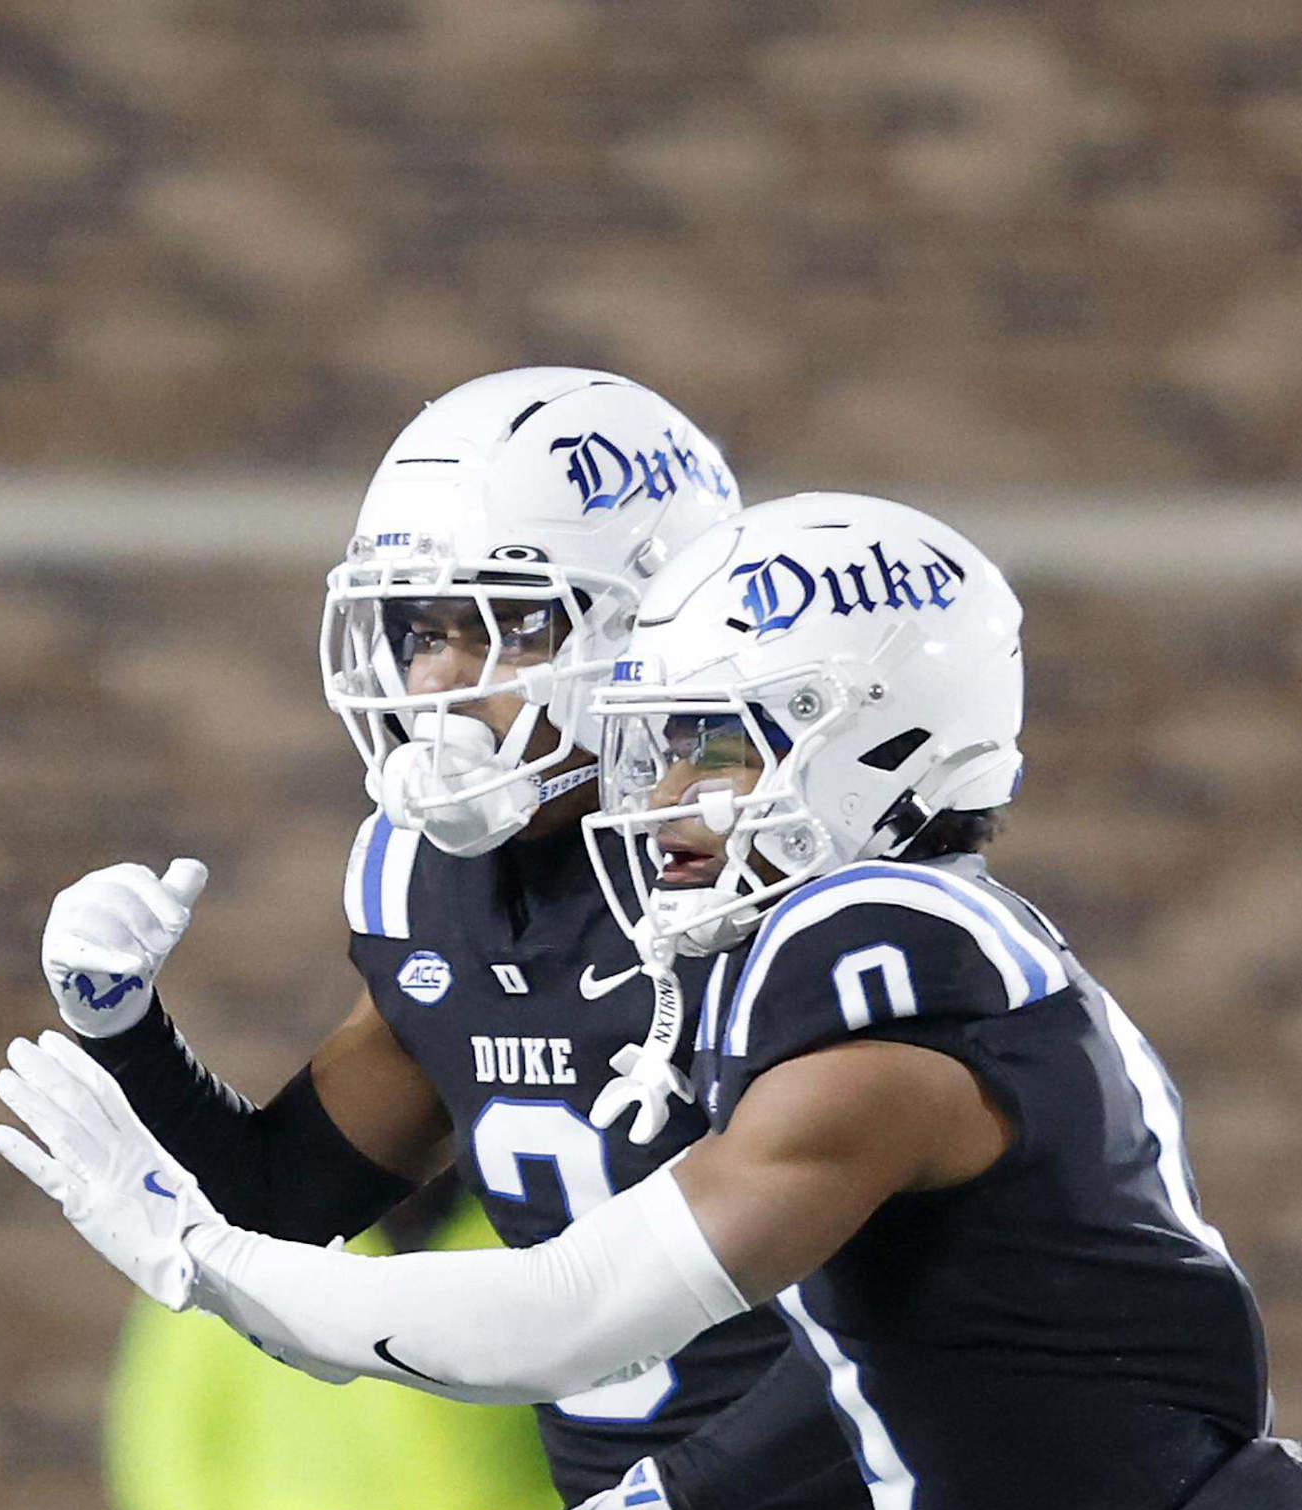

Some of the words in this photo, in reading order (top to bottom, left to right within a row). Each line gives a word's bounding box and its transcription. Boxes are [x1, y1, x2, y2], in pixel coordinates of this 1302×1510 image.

[727, 541, 956, 641] Duke
[406, 965, 445, 983] ACC
[470, 1035, 578, 1085] DUKE
